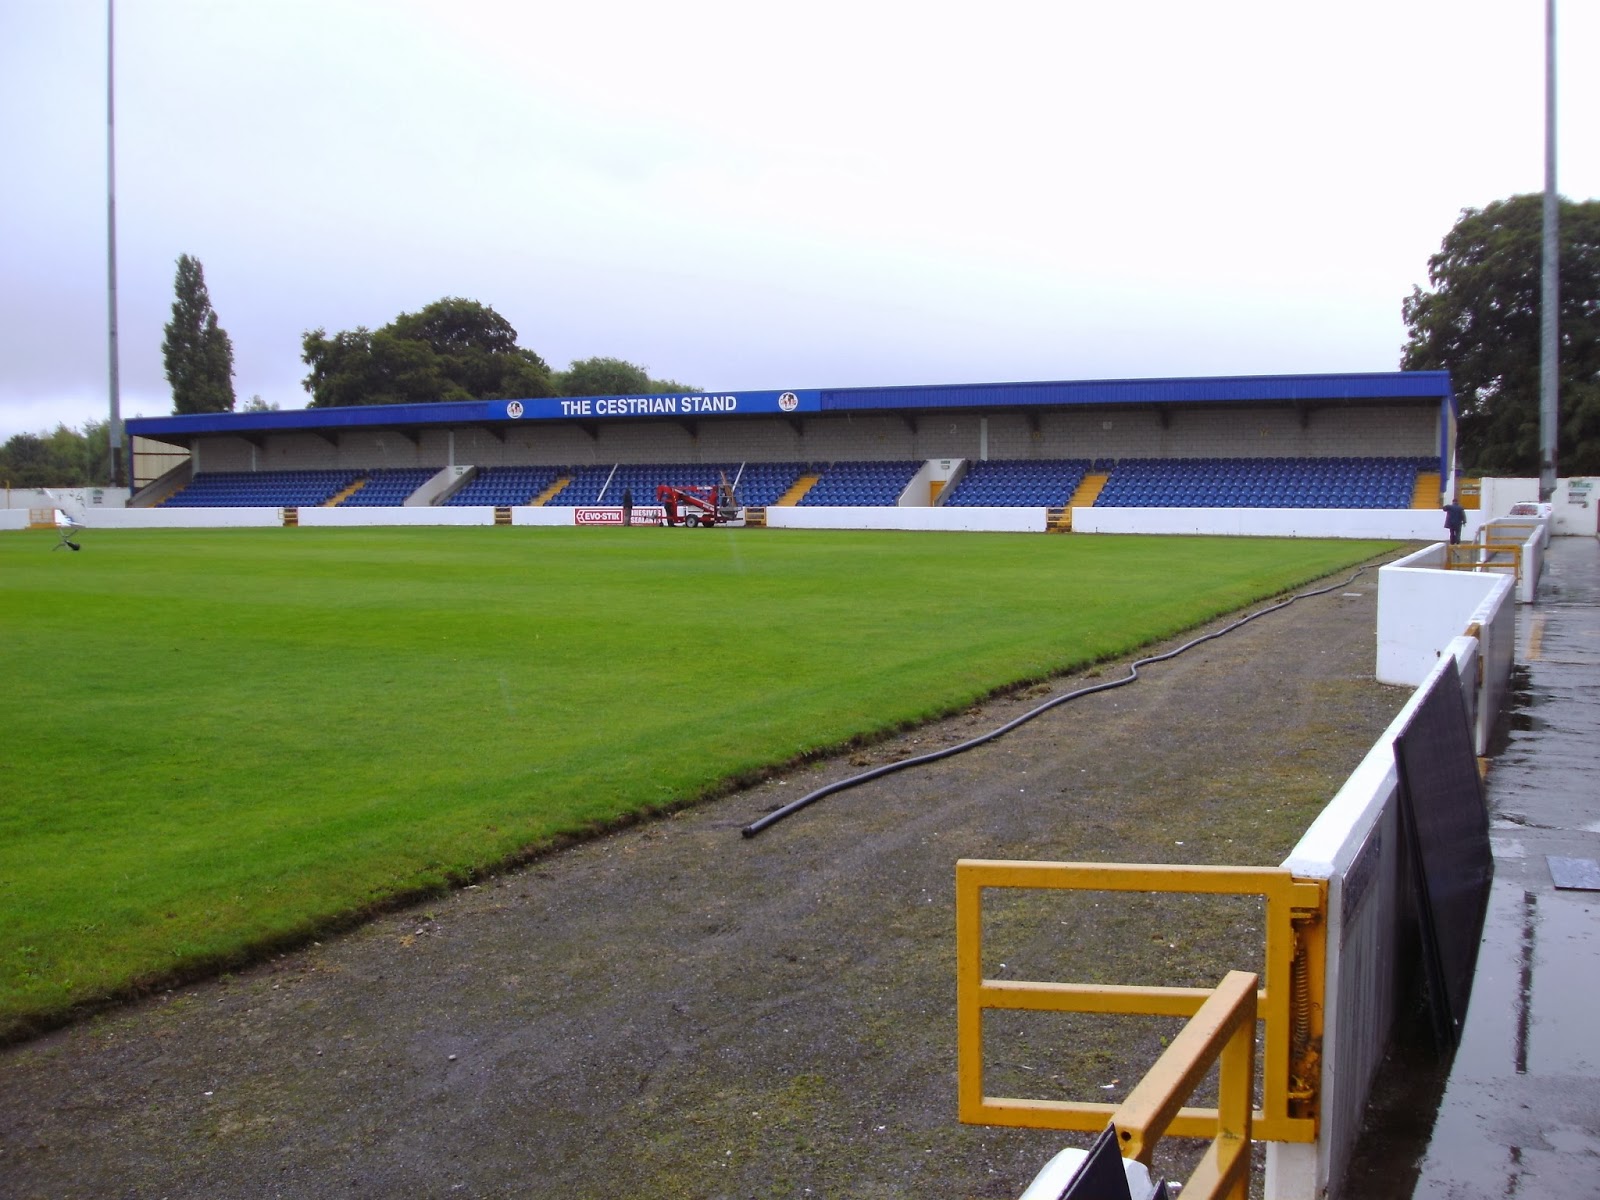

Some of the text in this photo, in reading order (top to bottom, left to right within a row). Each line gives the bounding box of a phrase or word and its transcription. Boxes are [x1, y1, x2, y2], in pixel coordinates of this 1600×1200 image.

[561, 396, 737, 415] THE CESTRIAN STAND
